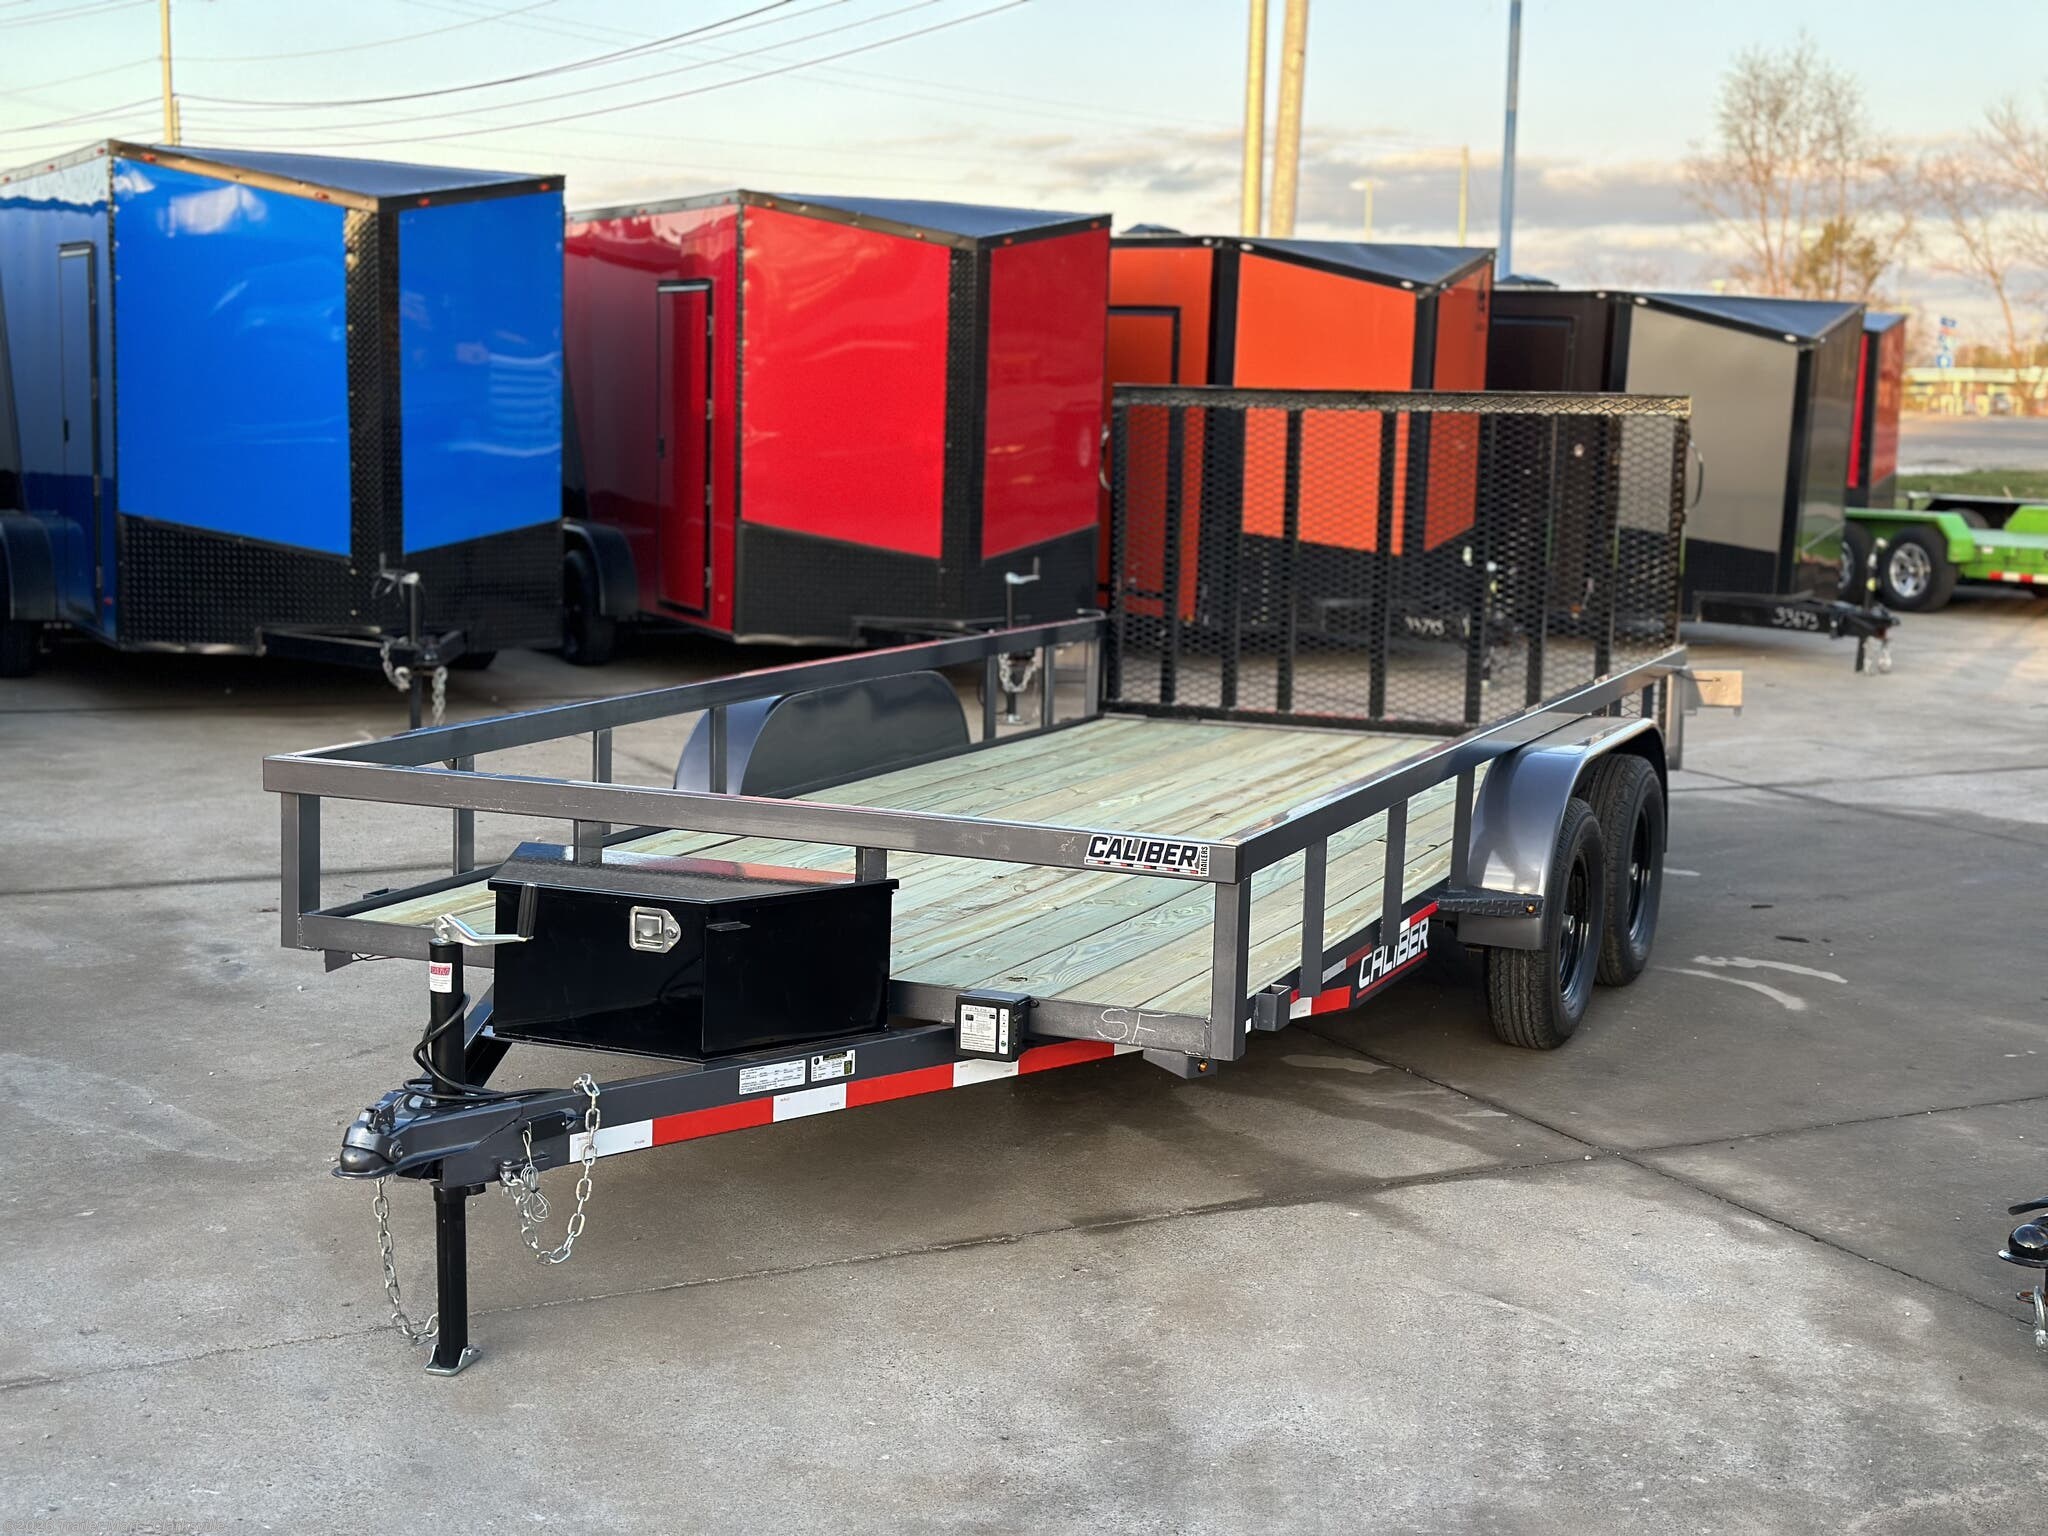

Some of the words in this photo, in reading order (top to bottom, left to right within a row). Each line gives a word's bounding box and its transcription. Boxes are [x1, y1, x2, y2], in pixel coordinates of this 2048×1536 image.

[1088, 836, 1199, 867] CALIBER
[1200, 846, 1209, 875] TRAILERS
[1358, 917, 1429, 989] CALIBER
